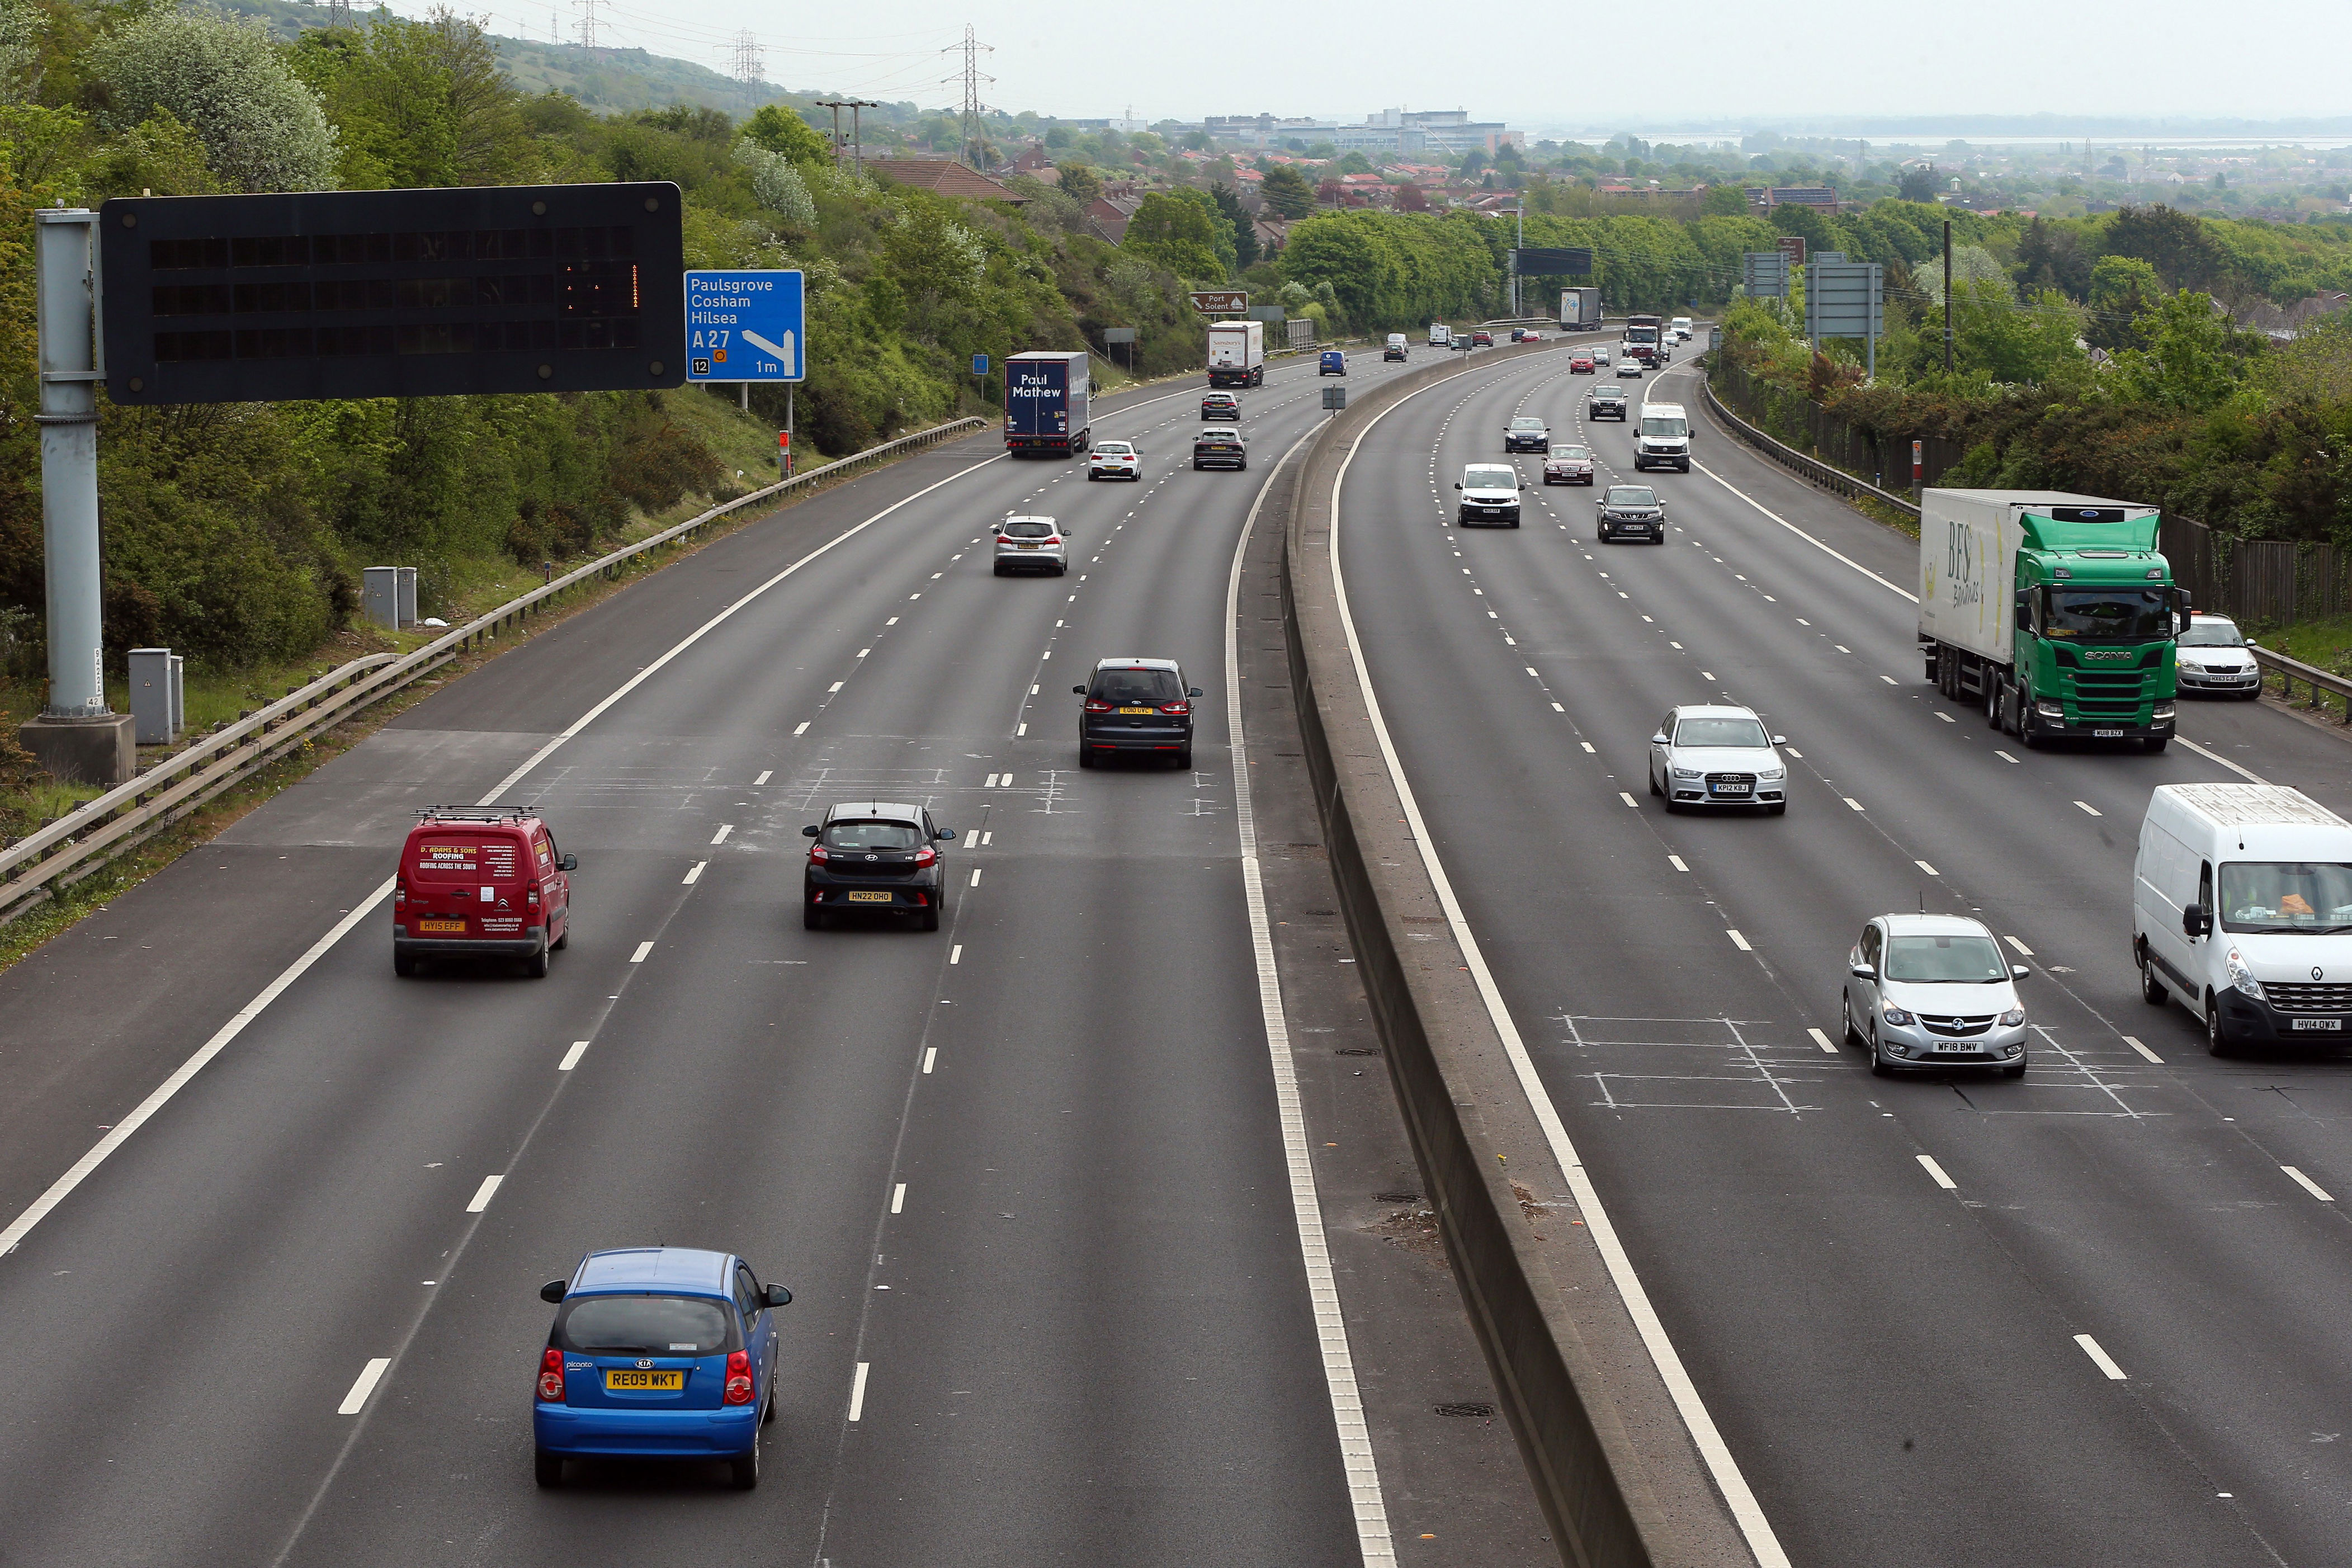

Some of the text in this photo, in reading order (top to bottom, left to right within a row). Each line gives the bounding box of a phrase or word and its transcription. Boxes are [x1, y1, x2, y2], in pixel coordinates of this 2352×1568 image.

[691, 278, 773, 294] Paulsgrove
[692, 295, 750, 308] Cosham
[692, 311, 738, 324] Hilsea
[695, 361, 707, 371] 12
[1021, 374, 1047, 385] Paul
[1013, 386, 1061, 397] Mathew
[1948, 521, 1970, 584] BFS
[2085, 651, 2133, 660] SCANIA
[1938, 1042, 1977, 1051] WF18 BMV
[566, 1361, 593, 1369] picanto
[612, 1373, 677, 1386] RE09 WKT
